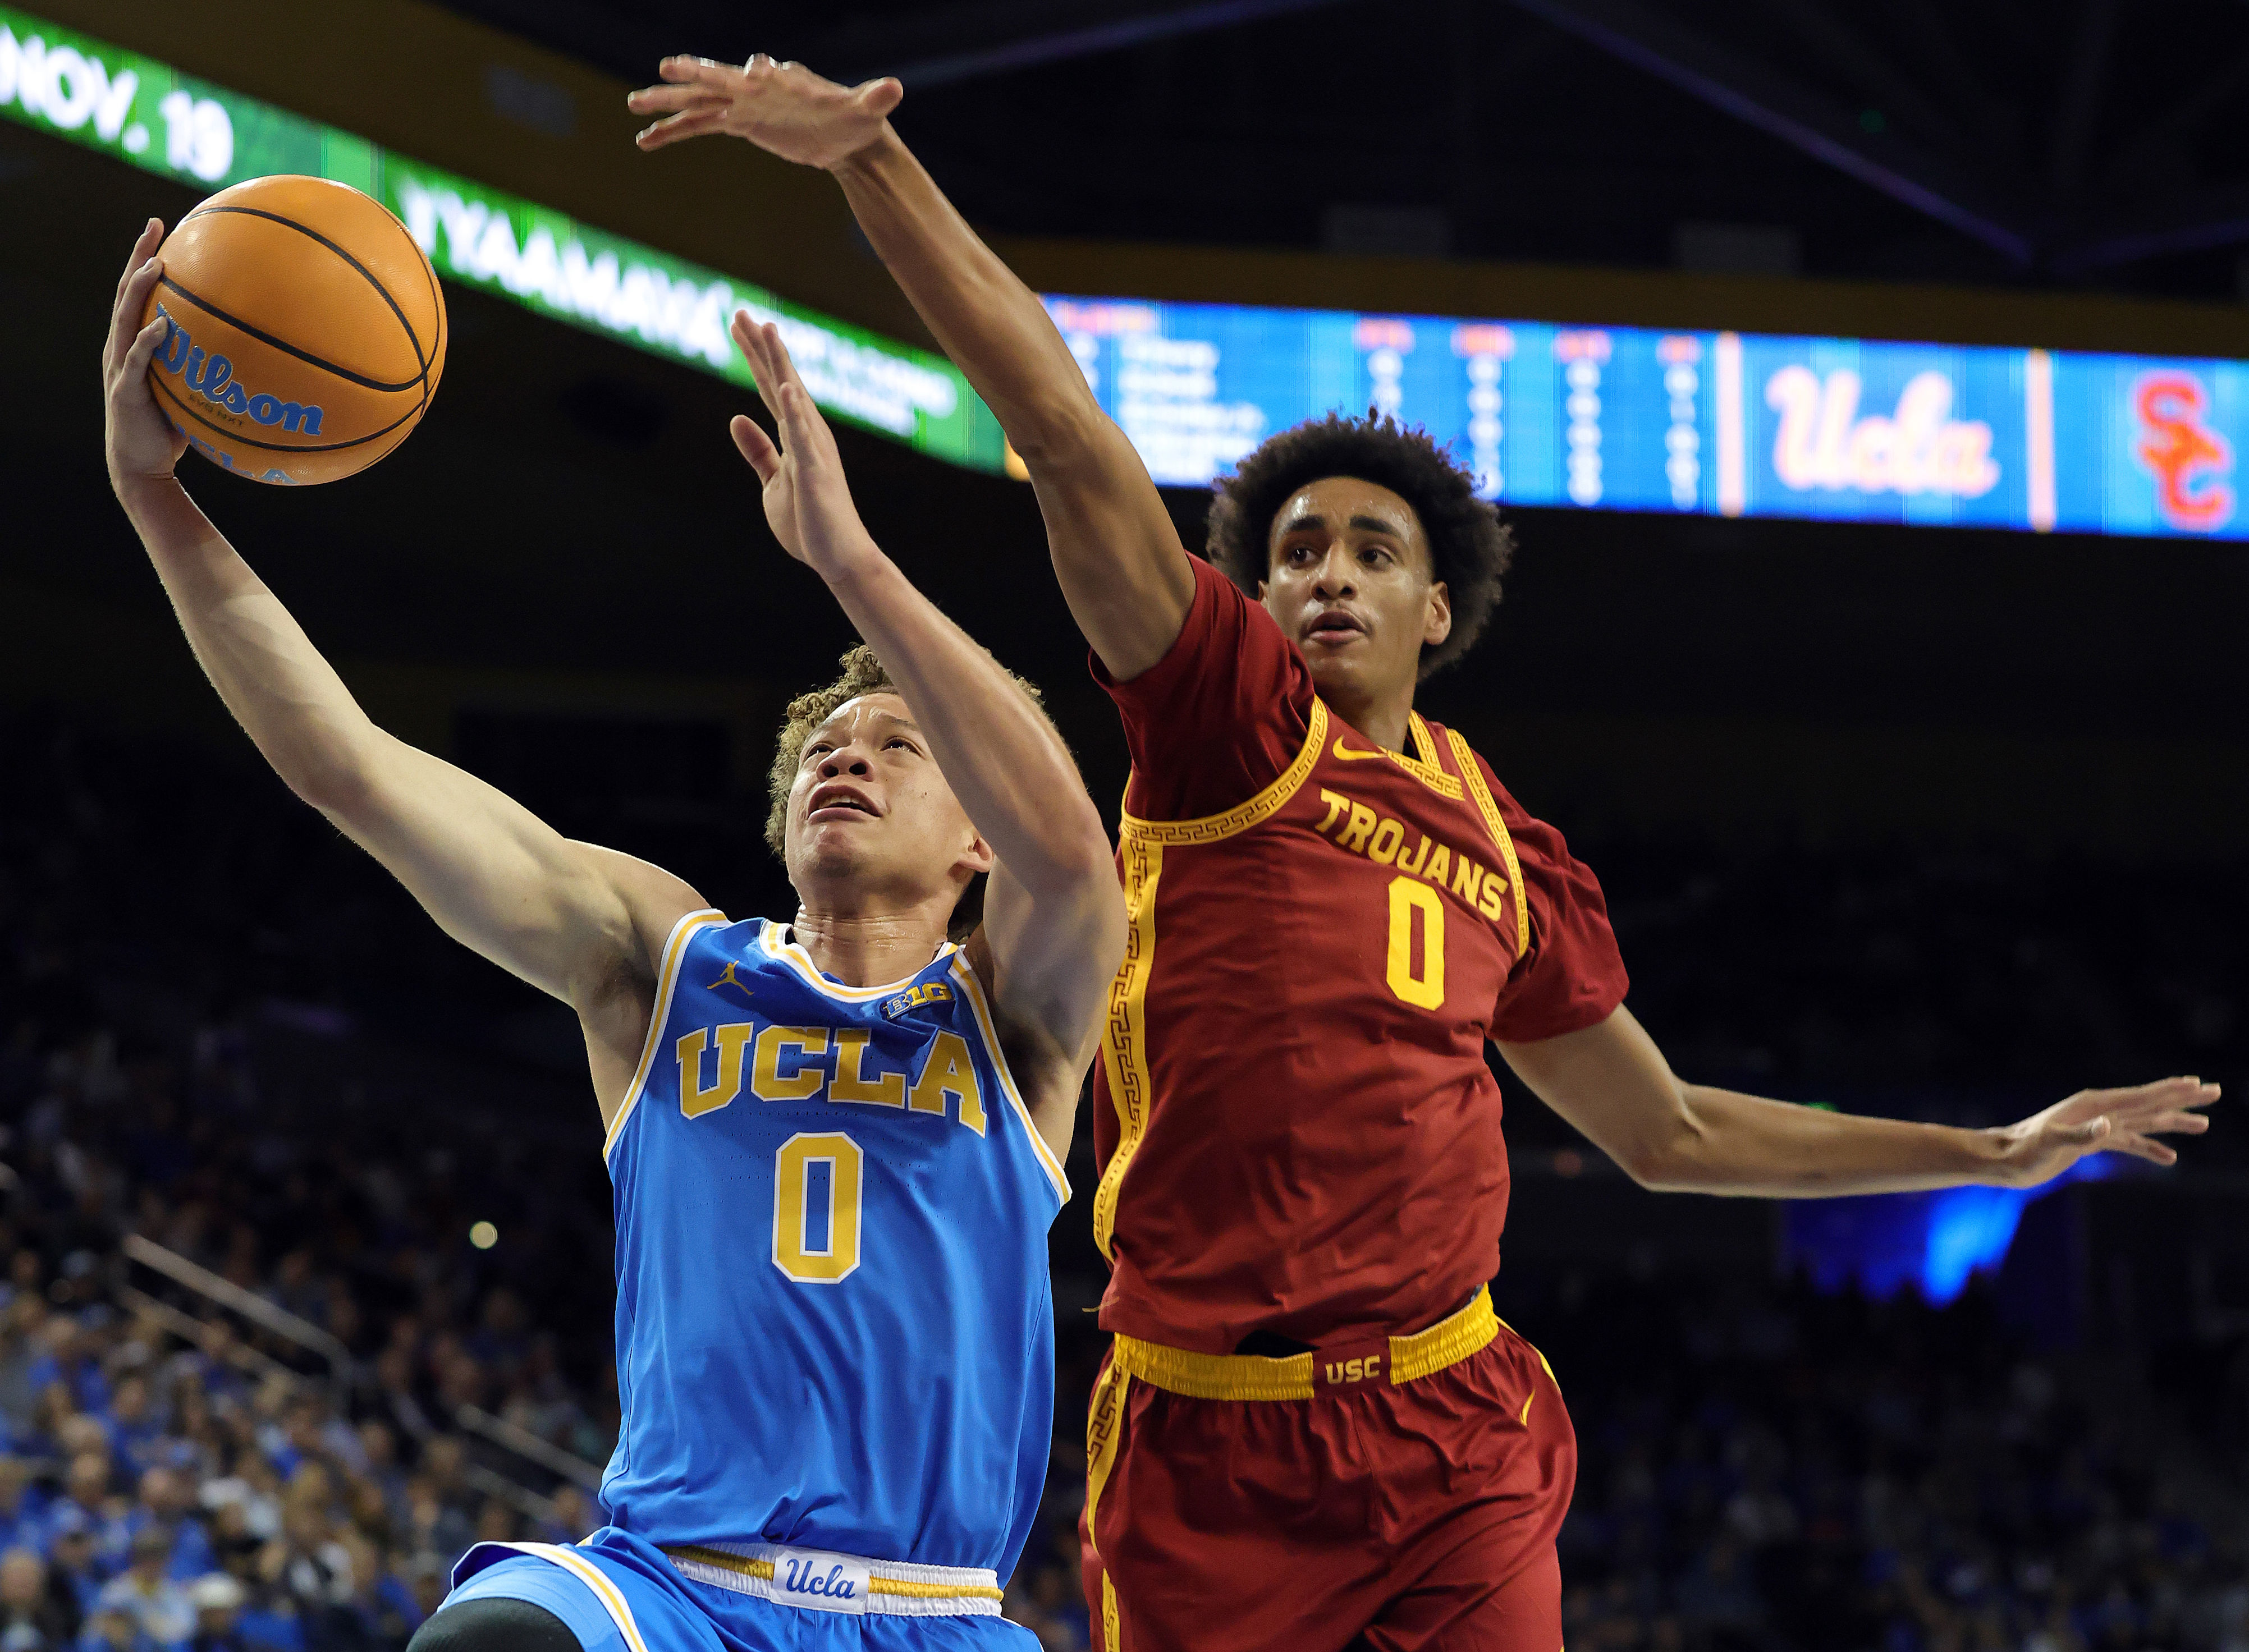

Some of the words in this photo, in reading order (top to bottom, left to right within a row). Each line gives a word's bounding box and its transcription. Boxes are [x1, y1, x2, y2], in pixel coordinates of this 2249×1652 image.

[154, 301, 323, 436] Wilson
[1310, 788, 1509, 923] TROJANS
[1386, 874, 1445, 1012] 0
[676, 1022, 987, 1139] UCLA
[772, 1131, 864, 1284] 0
[1325, 1354, 1381, 1385] USC
[786, 1558, 856, 1599] Ucla
